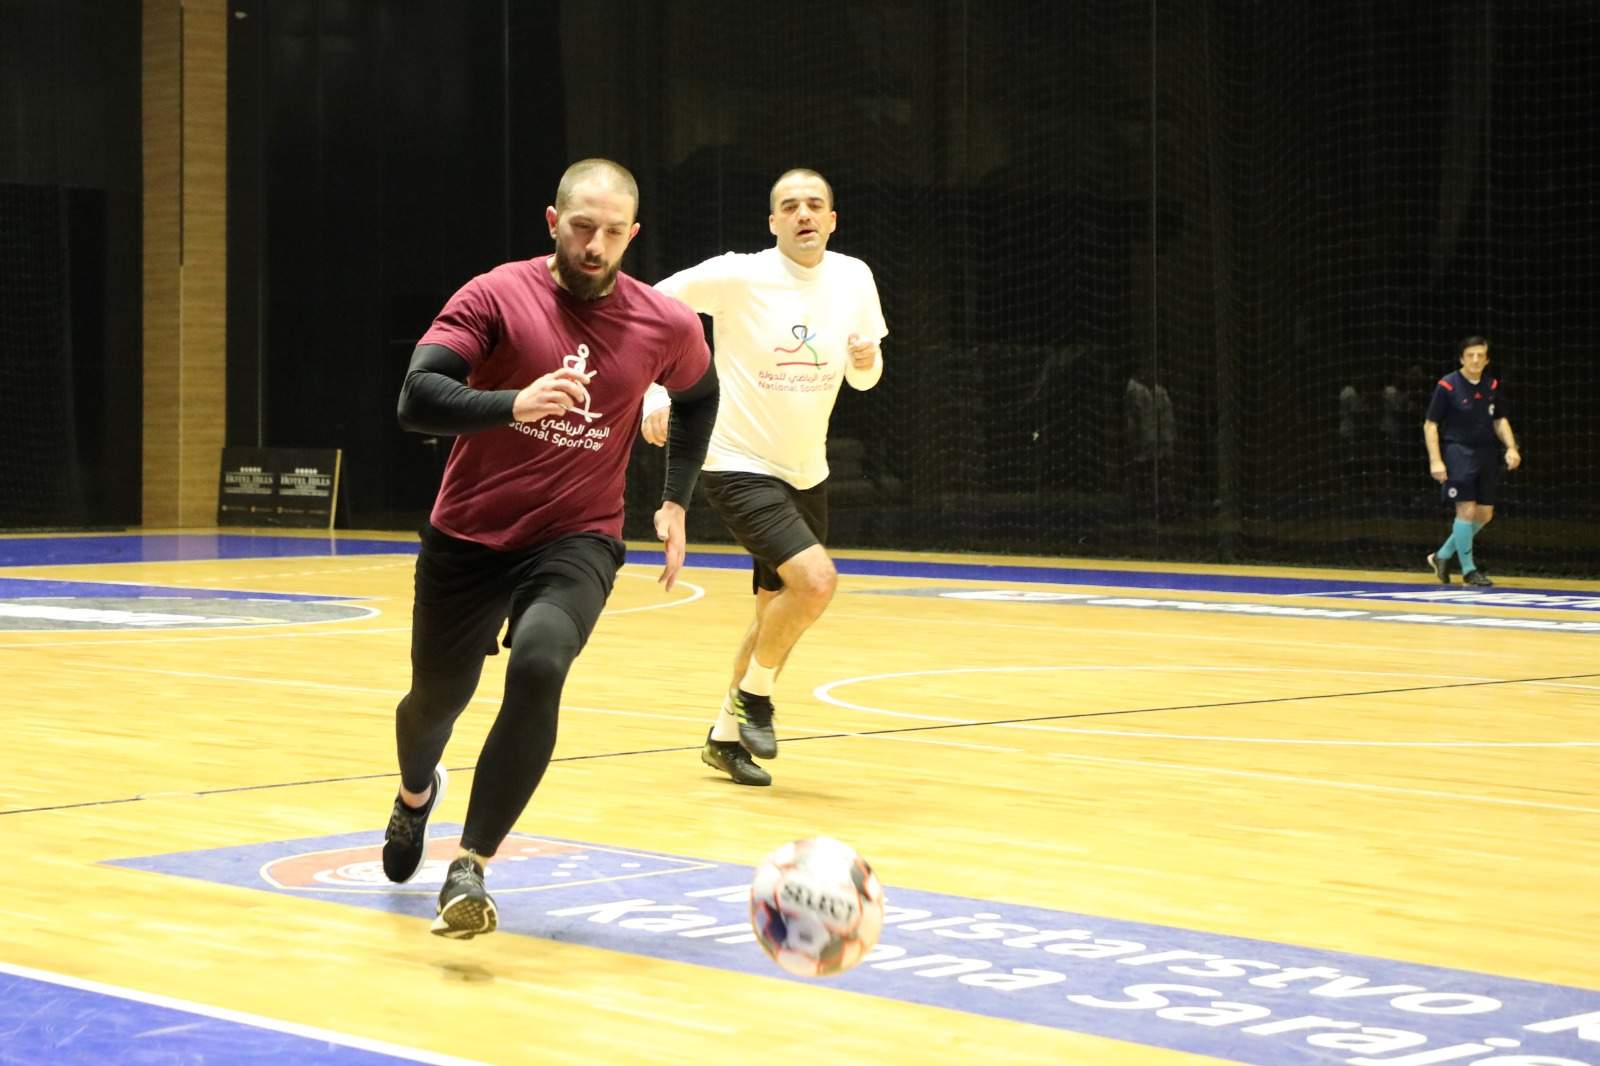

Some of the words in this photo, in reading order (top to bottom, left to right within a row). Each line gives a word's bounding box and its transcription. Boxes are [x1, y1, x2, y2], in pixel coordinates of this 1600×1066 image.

[508, 421, 549, 442] tional
[551, 433, 584, 448] Sport
[583, 438, 605, 452] Day
[782, 881, 854, 923] SELECT
[547, 899, 1066, 990] Kanna
[684, 884, 1502, 1015] nistarstvo
